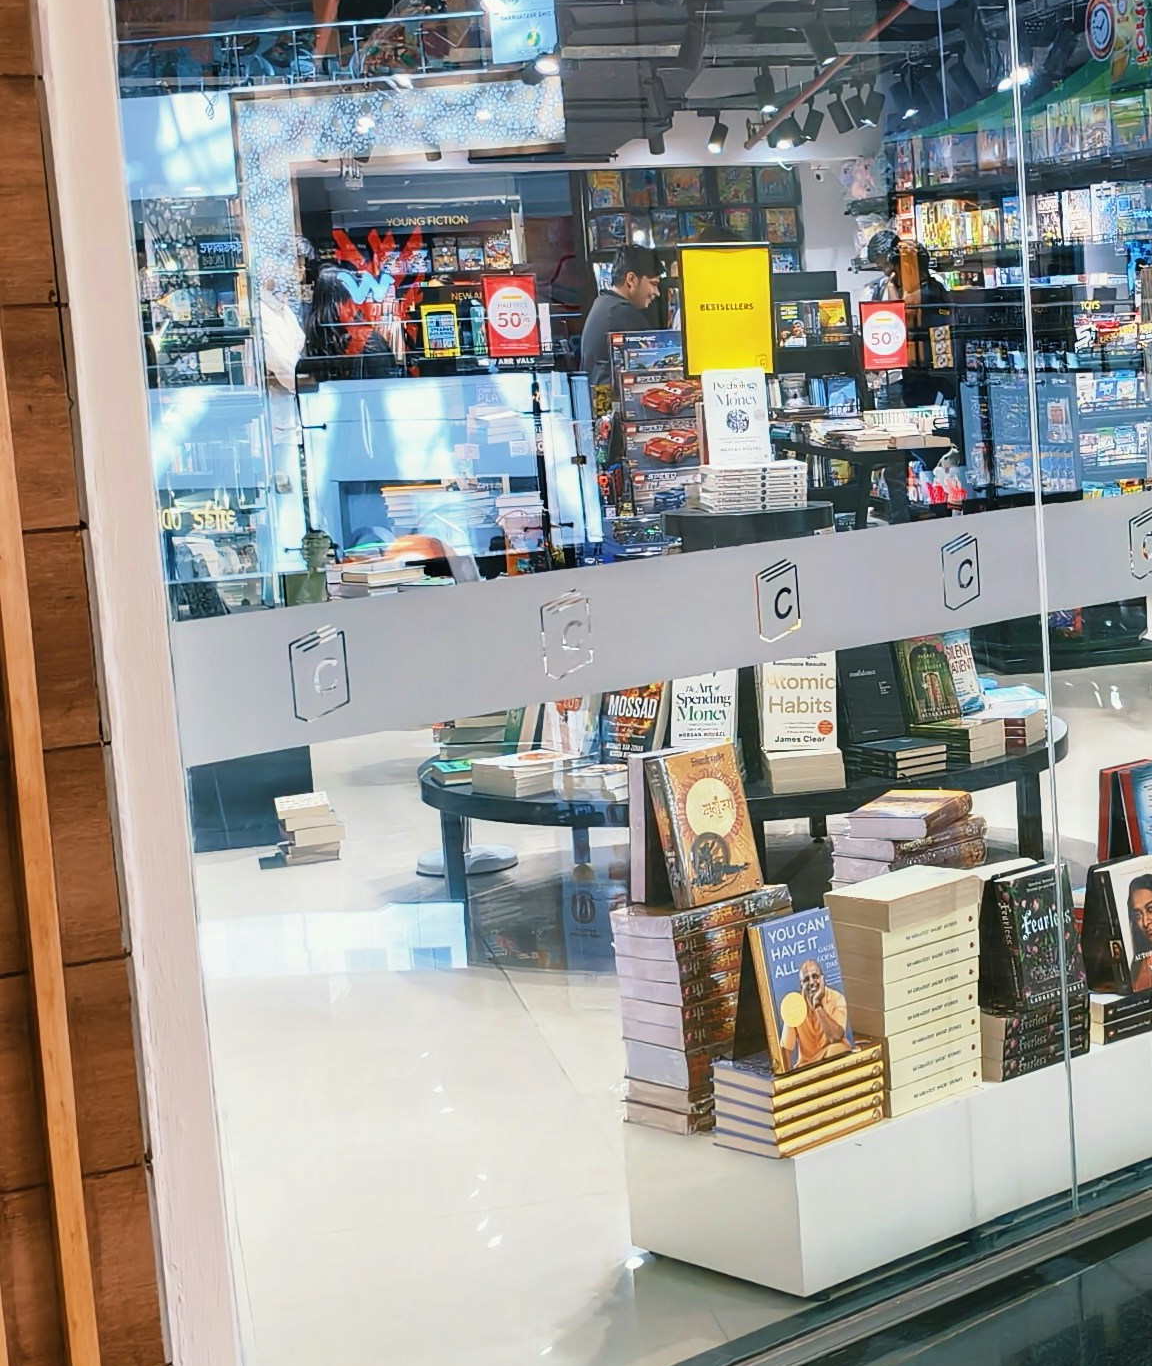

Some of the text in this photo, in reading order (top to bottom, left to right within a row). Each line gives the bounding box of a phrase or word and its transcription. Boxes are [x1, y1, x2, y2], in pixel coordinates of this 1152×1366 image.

[386, 215, 469, 227] YOUNG FICTION
[700, 303, 754, 311] BESTSELLERS
[1079, 300, 1100, 310] TOYS
[698, 682, 713, 694] Art
[767, 672, 837, 690] Atomic
[607, 694, 658, 719] MOSSAD
[676, 692, 732, 708] Spending
[769, 695, 833, 714] Habits
[676, 705, 727, 722] Money
[775, 735, 826, 743] James Clear
[767, 917, 826, 945] YOU CAN
[770, 936, 819, 962] HAVE IT
[774, 963, 799, 979] ALL
[826, 959, 838, 970] DAS
[1030, 990, 1055, 1005] LAUREN
